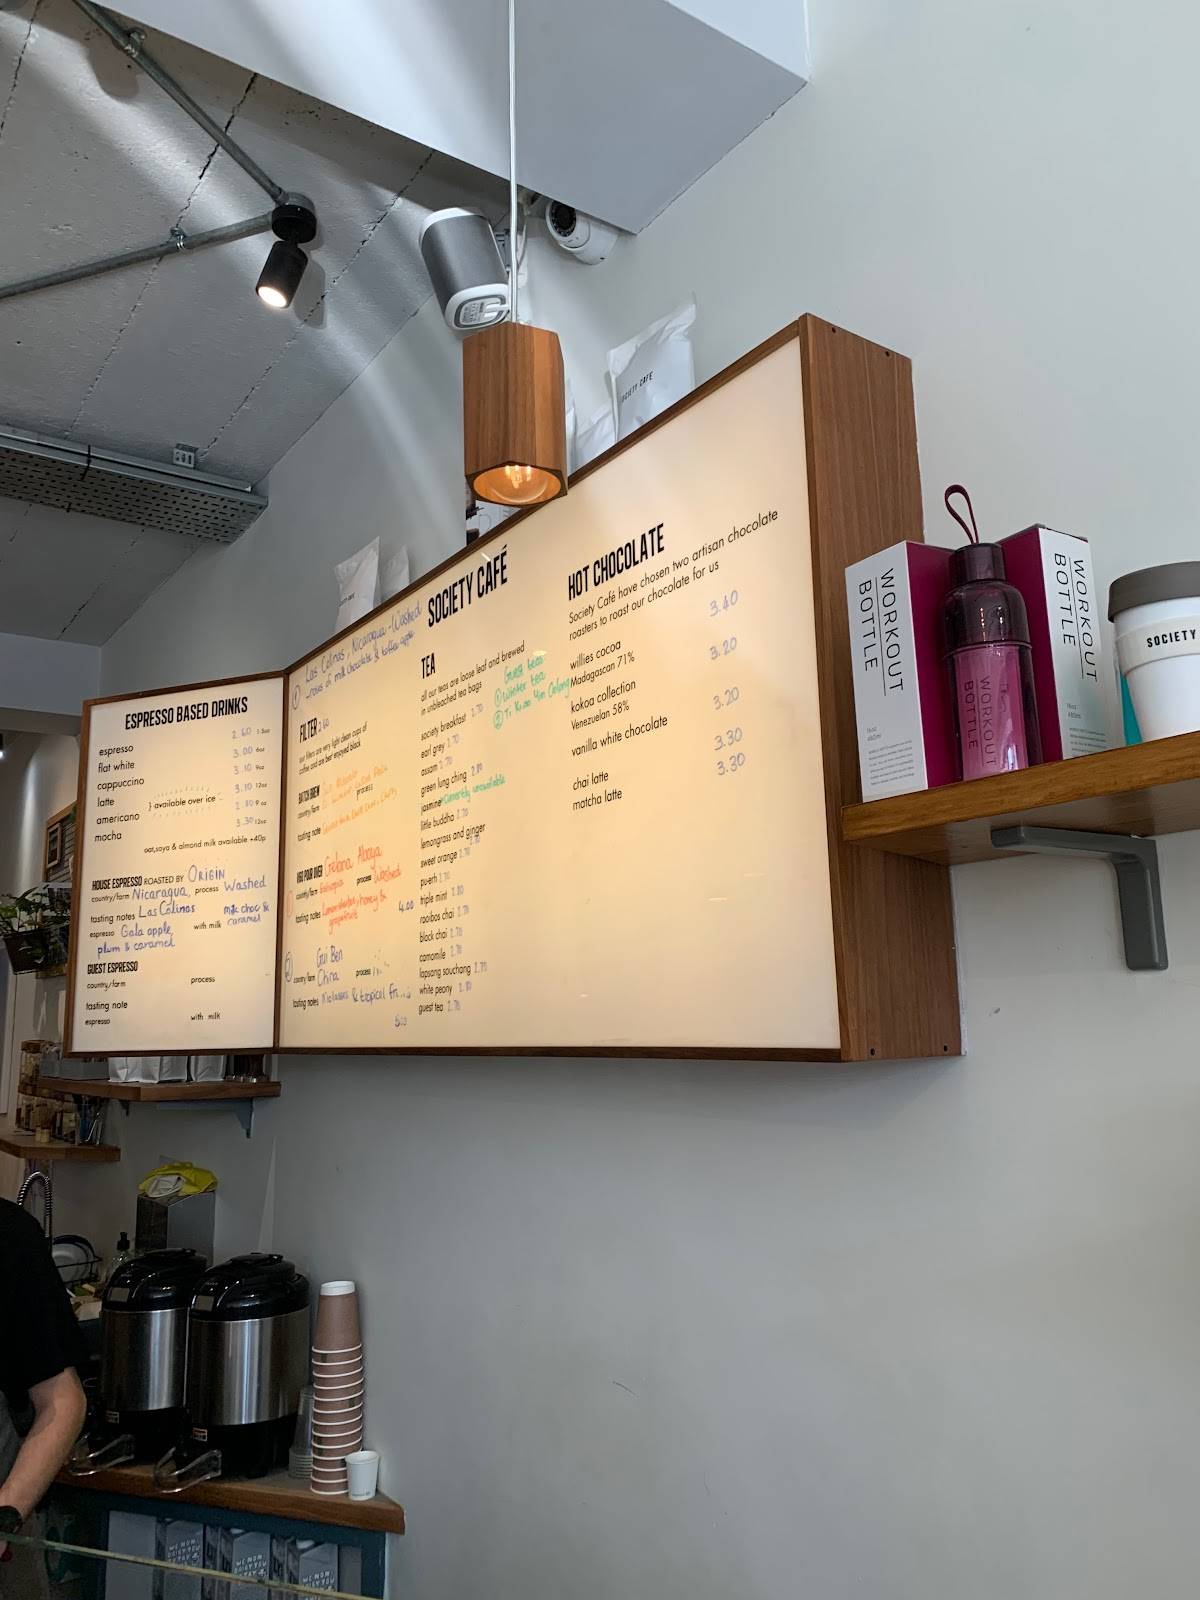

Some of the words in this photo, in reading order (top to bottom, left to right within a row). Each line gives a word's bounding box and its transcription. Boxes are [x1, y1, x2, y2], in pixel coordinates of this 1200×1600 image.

[569, 565, 589, 601] HOT
[593, 522, 665, 587] CHOCOLATE
[569, 602, 595, 624] Society
[597, 590, 616, 610] Café
[618, 585, 638, 601] have
[640, 566, 670, 588] chosen
[673, 556, 689, 571] two
[692, 537, 724, 561] artisan
[728, 509, 778, 543] chocolate
[428, 572, 473, 627] SOCIETY
[477, 545, 507, 598] CAFÉ
[569, 619, 598, 641] roasters
[600, 615, 607, 627] to
[609, 605, 629, 622] roast
[632, 597, 644, 611] our
[648, 574, 690, 603] chocolate
[693, 567, 705, 581] for
[709, 561, 719, 573] us
[1054, 553, 1077, 646] BOTTLE
[858, 580, 878, 672] BOTTLE
[1073, 559, 1097, 682] WORKOUT
[880, 568, 905, 691] WORKOUT
[1147, 629, 1195, 648] SOCIETY
[570, 652, 594, 670] willies
[596, 641, 621, 659] cocoa
[421, 653, 435, 679] TEA
[438, 682, 448, 693] teas
[450, 676, 458, 687] are
[460, 669, 474, 682] loose
[476, 659, 487, 674] leaf
[488, 656, 499, 669] and
[501, 640, 525, 662] brewed
[571, 662, 615, 688] Madagascan
[617, 651, 635, 668] 71%
[427, 690, 456, 713] unbleached
[458, 688, 467, 698] tea
[468, 681, 482, 697] bags
[571, 695, 595, 714] kokoa
[597, 680, 636, 703] collection
[125, 707, 173, 730] ESPRESSO
[177, 702, 208, 722] BASED
[211, 697, 248, 717] DRINKS
[571, 709, 610, 731] Venezuelan
[612, 700, 630, 716] 58%
[964, 680, 978, 749] BOTTLE
[980, 675, 996, 764] WORKOUT
[300, 718, 318, 743] FILTER
[421, 726, 439, 741] society
[441, 713, 466, 733] breakfast
[350, 738, 360, 751] black
[572, 738, 598, 757] vanilla
[600, 732, 622, 748] white
[625, 715, 668, 738] chocolate
[714, 728, 743, 751] 3.30
[99, 744, 133, 757] espresso
[421, 744, 431, 758] earl
[433, 742, 445, 756] grey
[98, 763, 111, 773] flat
[113, 760, 134, 771] white
[421, 764, 438, 776] assam
[717, 753, 746, 776] 3.30
[98, 777, 144, 793] cappuccino
[421, 780, 436, 797] green
[438, 777, 450, 789] lung
[451, 771, 467, 783] ching
[573, 776, 589, 791] chai
[591, 771, 609, 785] latte
[98, 797, 114, 807] latte
[154, 799, 185, 809] available
[421, 799, 441, 815] jasmine
[573, 792, 602, 810] matcha
[605, 788, 622, 802] latte
[96, 812, 139, 824] americano
[421, 819, 431, 831] little
[433, 813, 454, 828] buddha
[95, 830, 122, 842] mocha
[179, 841, 201, 849] almond
[204, 839, 216, 847] milk
[218, 836, 247, 845] available
[421, 831, 451, 849] lemongrass
[453, 826, 464, 839] and
[466, 823, 485, 839] ginger
[421, 855, 436, 868] sweet
[437, 850, 458, 864] orange
[92, 878, 111, 891] HOUSE
[112, 876, 142, 889] ESPRESSO
[144, 877, 173, 885] ROASTED
[195, 886, 219, 895] process
[224, 875, 266, 892] Washed
[420, 893, 433, 906] triple
[435, 891, 448, 902] mint
[91, 916, 113, 925] tasting
[116, 913, 135, 921] notes
[420, 910, 441, 924] rooibos
[442, 908, 454, 920] chai
[90, 930, 114, 938] espresso
[121, 924, 144, 938] Gala
[420, 930, 434, 943] black
[435, 928, 448, 939] chai
[419, 948, 446, 962] camomile
[88, 963, 106, 974] GUEST
[107, 961, 138, 973] ESPRESSO
[419, 966, 441, 980] lapsang
[443, 963, 471, 977] souchong
[191, 976, 215, 985] process
[419, 983, 433, 995] white
[435, 984, 452, 996] peony
[86, 1003, 109, 1012] tasting
[112, 1001, 128, 1009] note
[419, 1002, 433, 1015] guest
[435, 1002, 443, 1012] tea
[85, 1018, 110, 1026] espresso
[191, 1012, 203, 1021] with
[208, 1012, 221, 1020] milk
